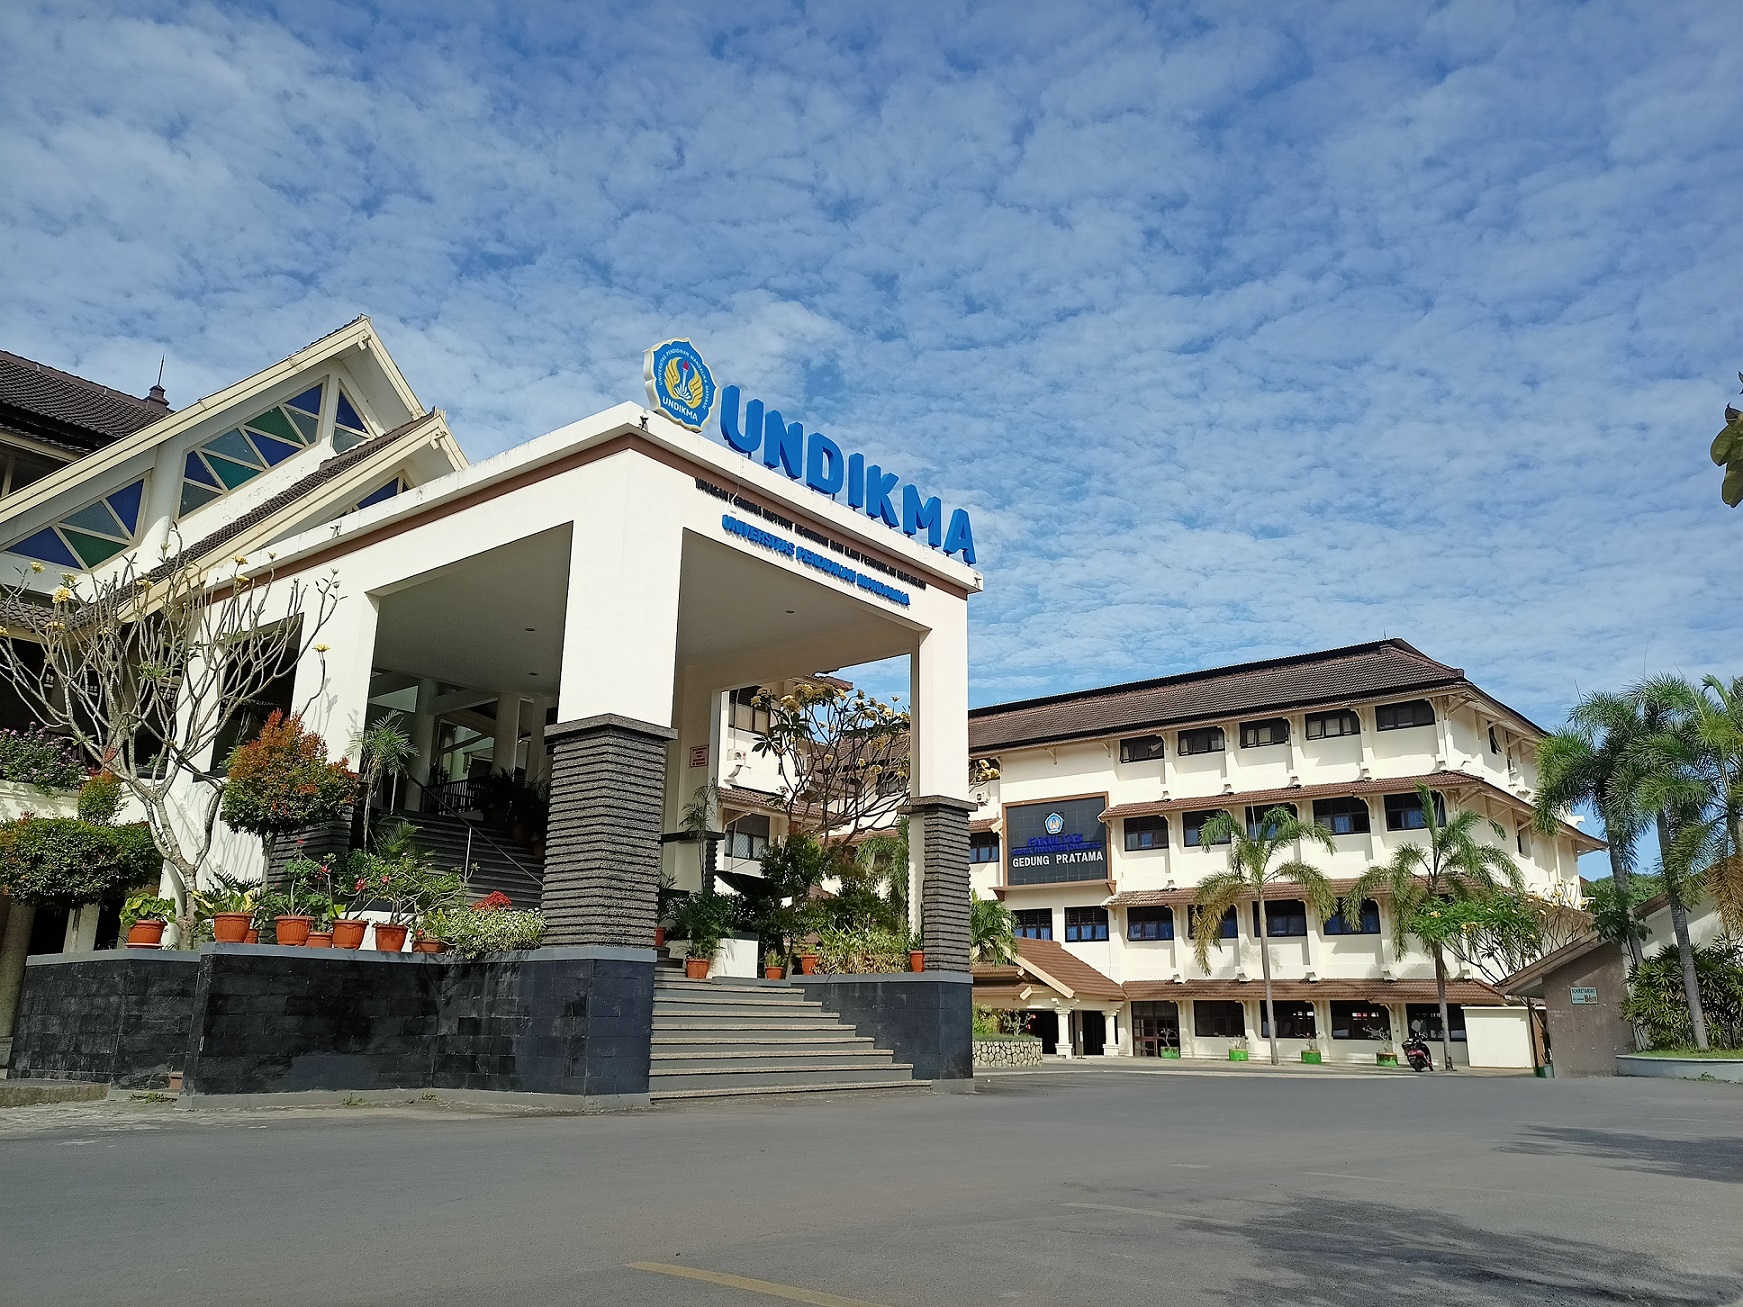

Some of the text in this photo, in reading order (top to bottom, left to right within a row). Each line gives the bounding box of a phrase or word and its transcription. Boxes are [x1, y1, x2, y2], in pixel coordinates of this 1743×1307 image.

[666, 348, 690, 358] PENDIDIKAN
[690, 354, 708, 384] MANDALIKA
[662, 396, 699, 422] UNDIKMA
[720, 384, 977, 565] UNDIKMA
[722, 514, 910, 606] UNIVERSITAS PENDIDIKAN MANDALIKA
[1013, 851, 1103, 868] GEDUNG PRATAMA
